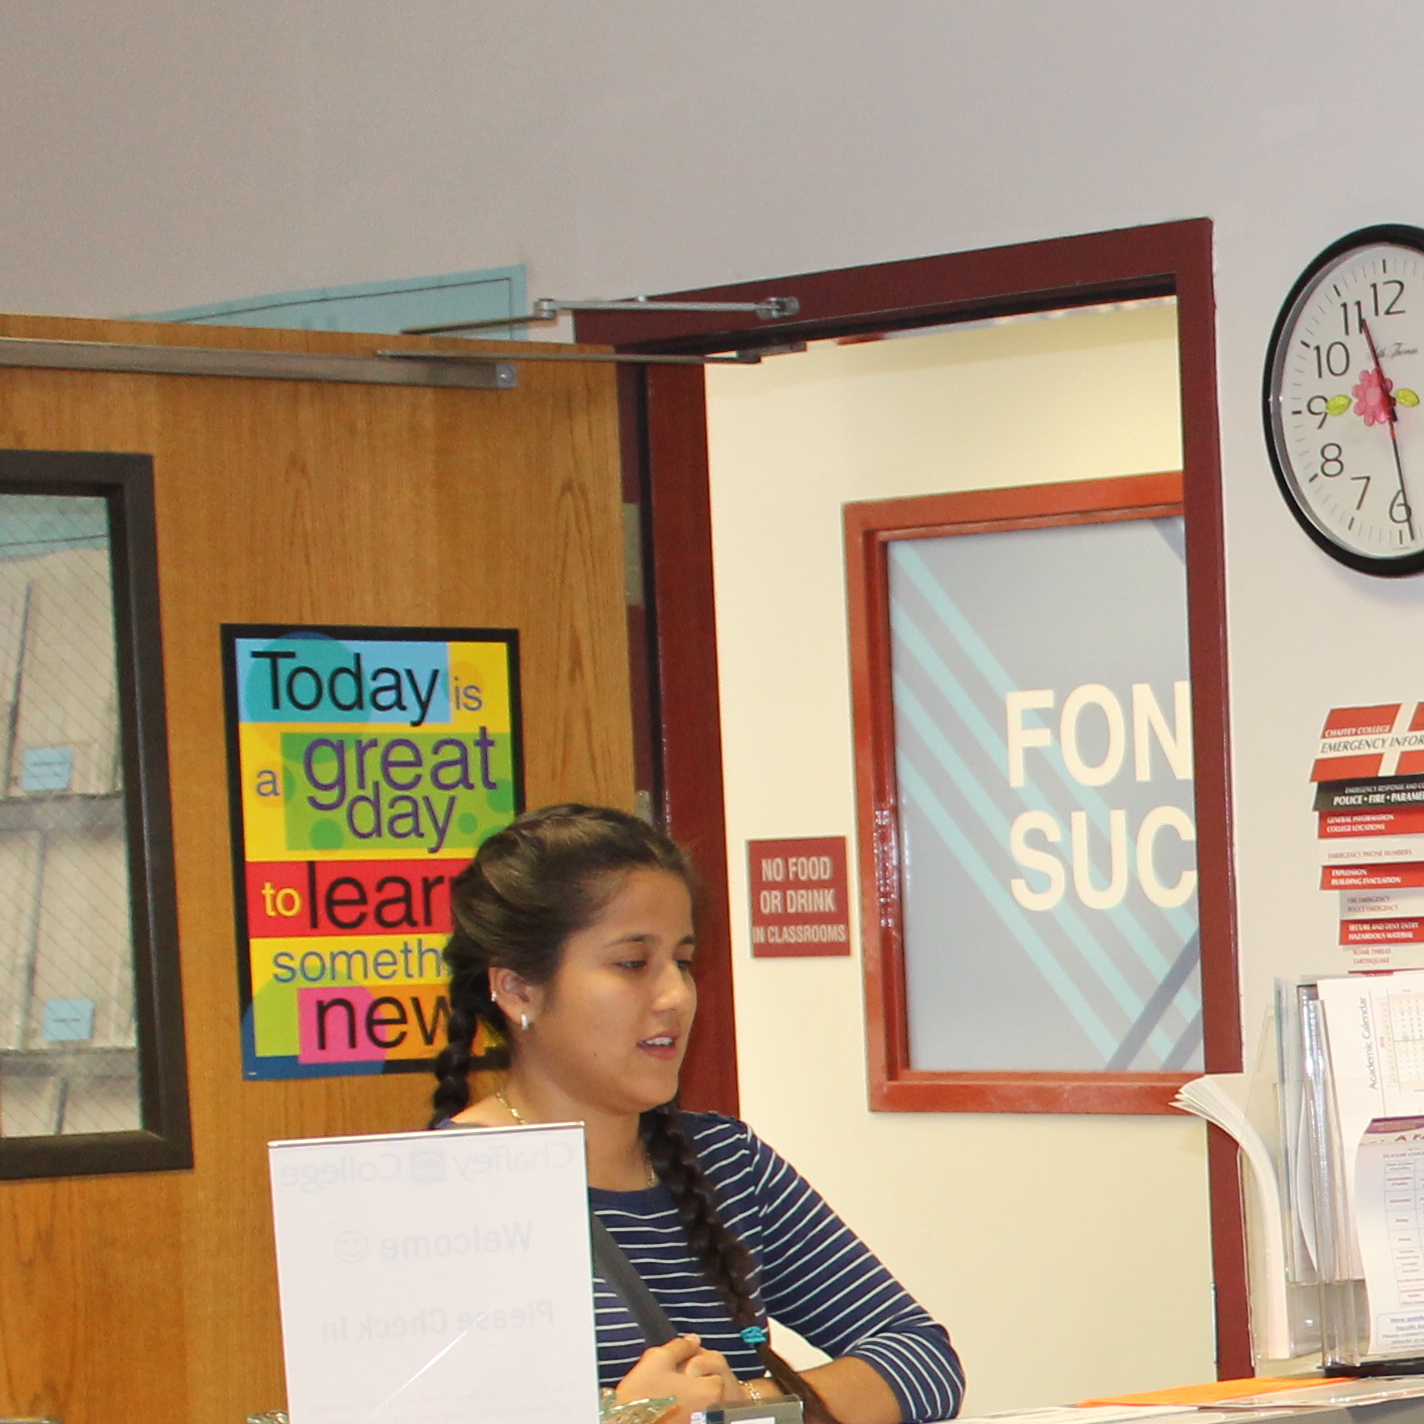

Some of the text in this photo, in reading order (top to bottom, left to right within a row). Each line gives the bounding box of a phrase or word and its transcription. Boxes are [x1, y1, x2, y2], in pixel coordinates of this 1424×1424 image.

[1370, 280, 1405, 316] 12
[1340, 300, 1363, 336] 11
[1313, 341, 1350, 379] 10
[1307, 395, 1329, 429] 9
[1320, 443, 1344, 477] 8
[1351, 476, 1371, 510] 7
[1389, 489, 1412, 524] 6
[251, 651, 483, 727] Today is
[1005, 680, 1192, 788] FON
[1321, 736, 1388, 754] EMERGENCY
[1357, 724, 1391, 735] COLLEGE
[256, 726, 498, 811] a great
[347, 781, 456, 853] day
[1333, 794, 1363, 806] POLICE
[1369, 793, 1386, 804] FIRE
[761, 856, 831, 881] NO FOOD
[1010, 805, 1197, 912] SUC
[262, 861, 459, 929] to lear
[760, 889, 835, 914] OR DRINK
[753, 924, 846, 943] IN CLASSROOMS
[273, 938, 446, 983] someth
[1359, 996, 1378, 1090] Academic Calendar
